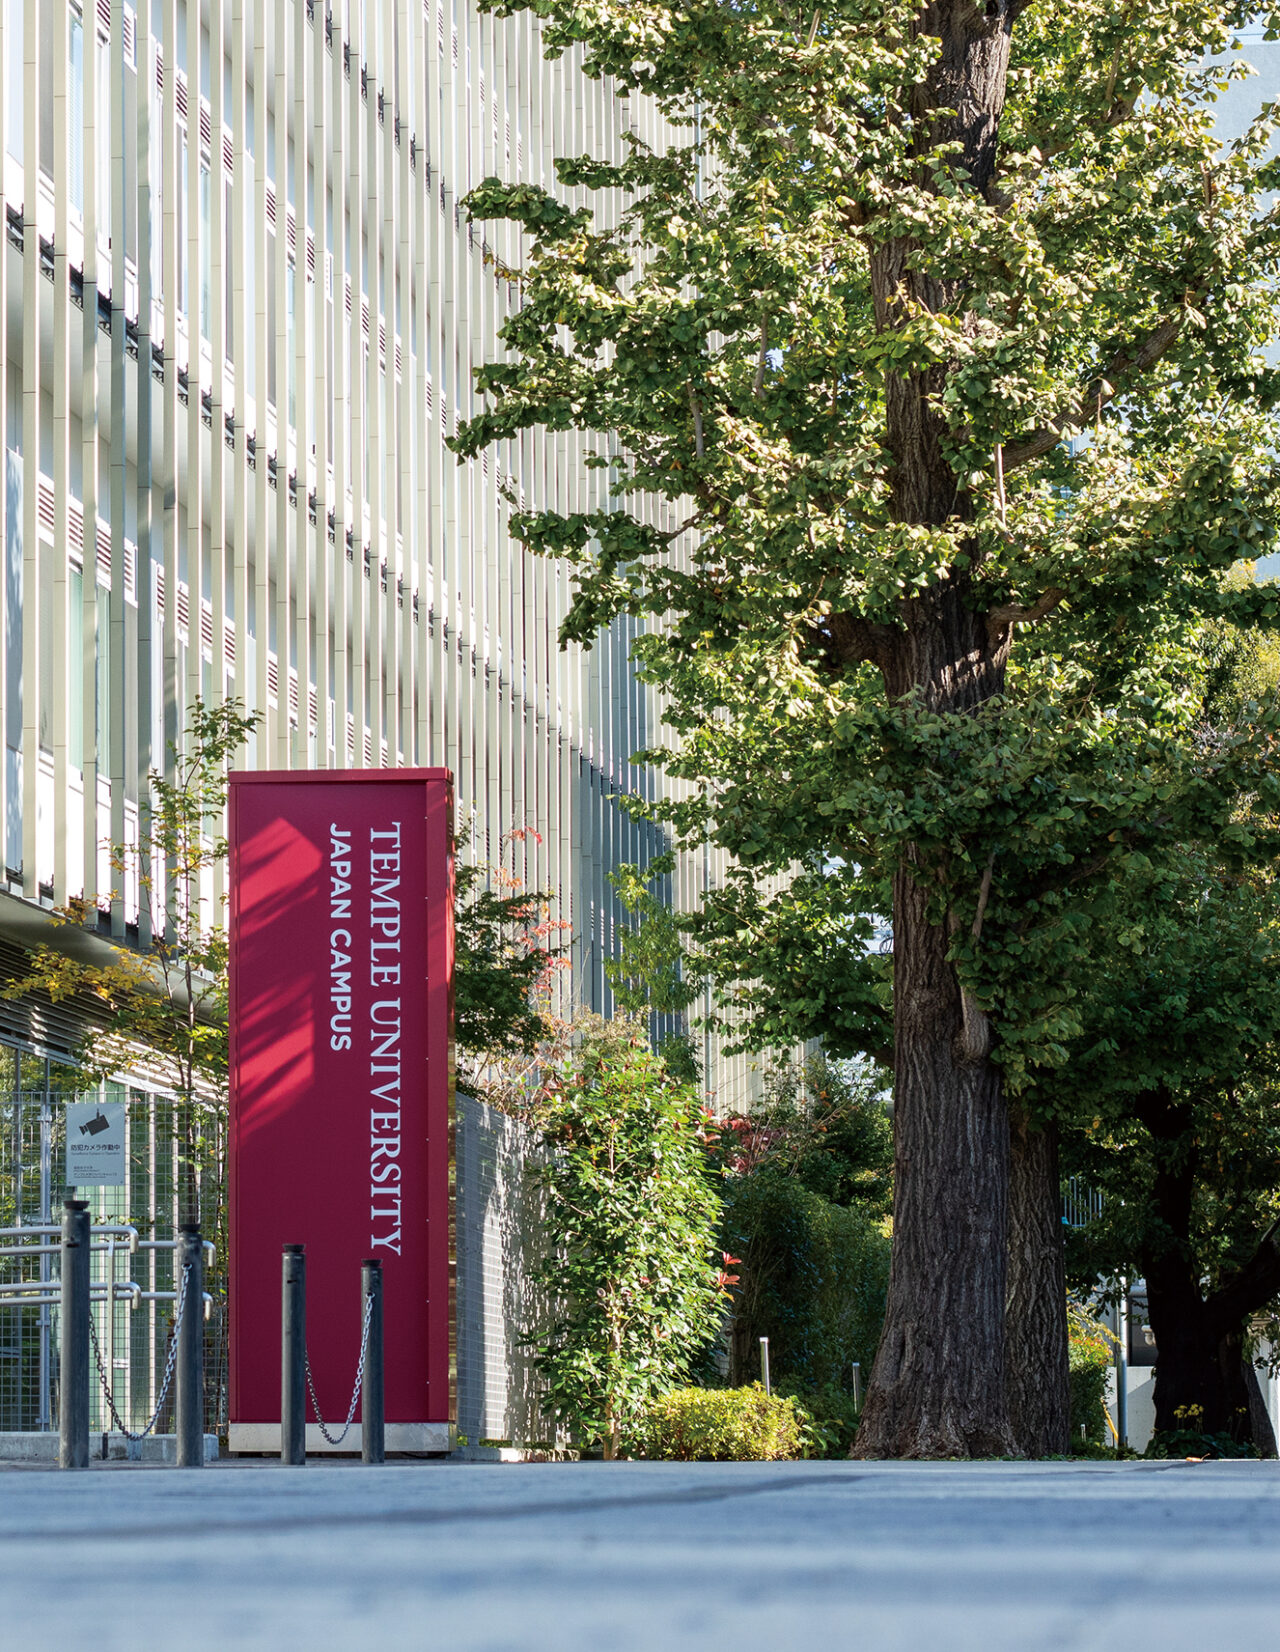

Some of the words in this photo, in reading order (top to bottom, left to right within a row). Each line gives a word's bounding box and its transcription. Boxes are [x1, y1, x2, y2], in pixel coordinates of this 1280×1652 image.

[330, 823, 352, 919] JAPAN
[370, 821, 401, 987] TEMPLE
[330, 928, 352, 1052] CAMPUS
[370, 998, 402, 1256] UNIVERSITY
